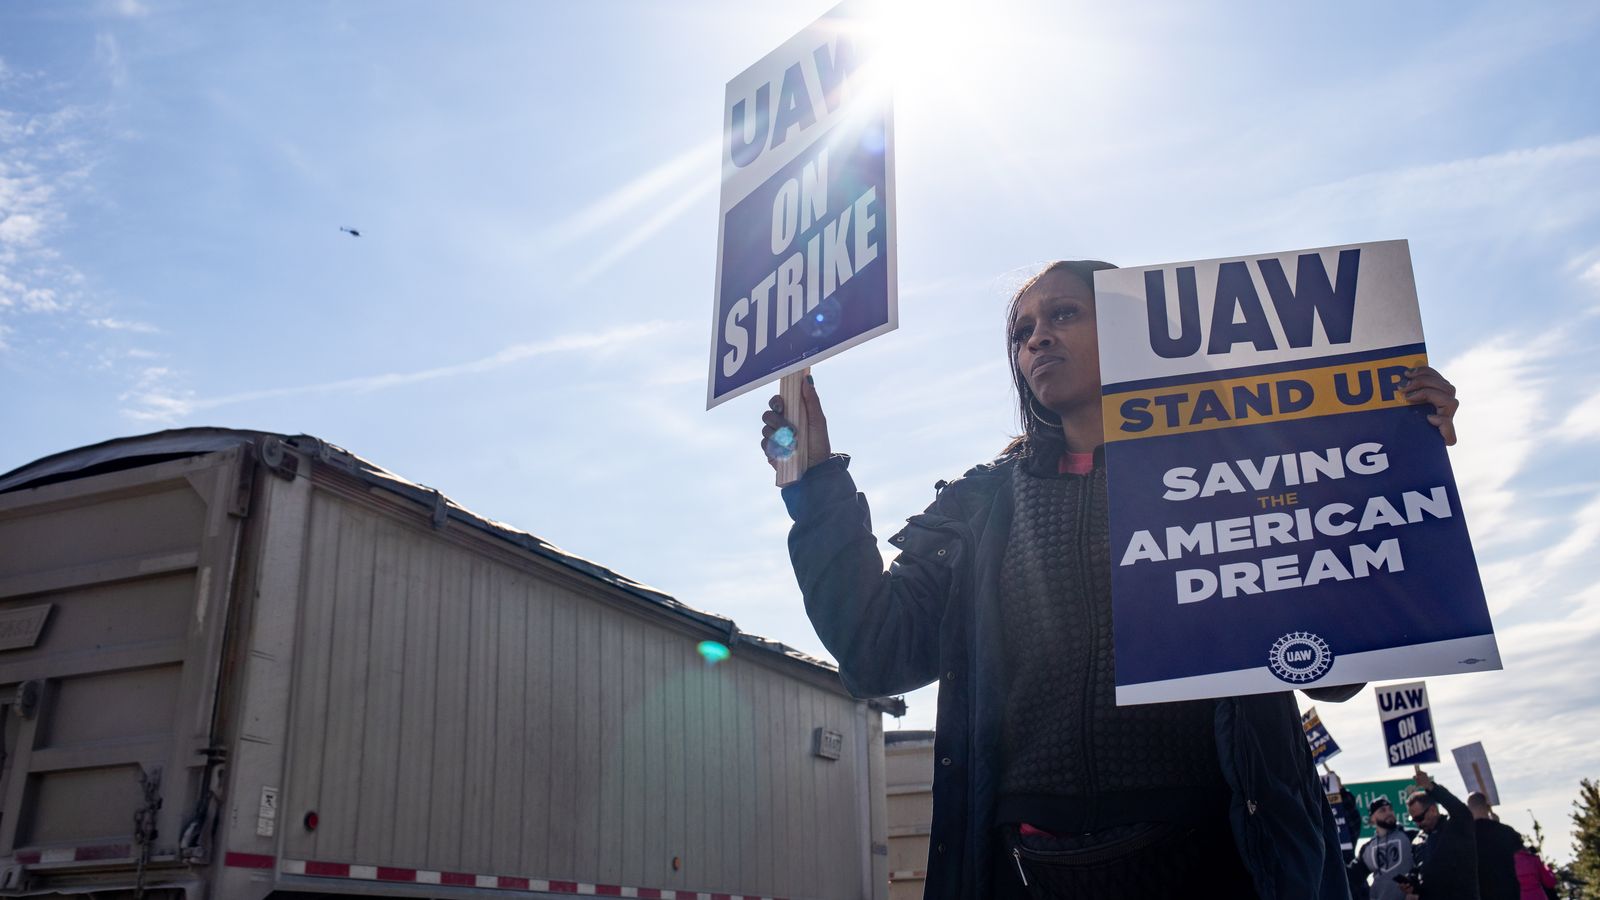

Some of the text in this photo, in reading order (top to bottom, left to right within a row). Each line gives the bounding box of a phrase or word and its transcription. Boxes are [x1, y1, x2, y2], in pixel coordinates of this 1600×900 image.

[771, 147, 829, 256] ON
[723, 185, 878, 378] STRIKE
[1144, 248, 1361, 359] UAW
[1119, 365, 1408, 433] STAND UP
[1162, 442, 1390, 501] SAVING
[1257, 492, 1298, 509] THE
[1120, 486, 1453, 567] AMERICAN
[1175, 537, 1405, 605] DREAM
[1286, 649, 1312, 662] UAW
[1378, 688, 1423, 712] UAW
[1398, 715, 1417, 739] ON
[1389, 730, 1434, 763] STRIKE
